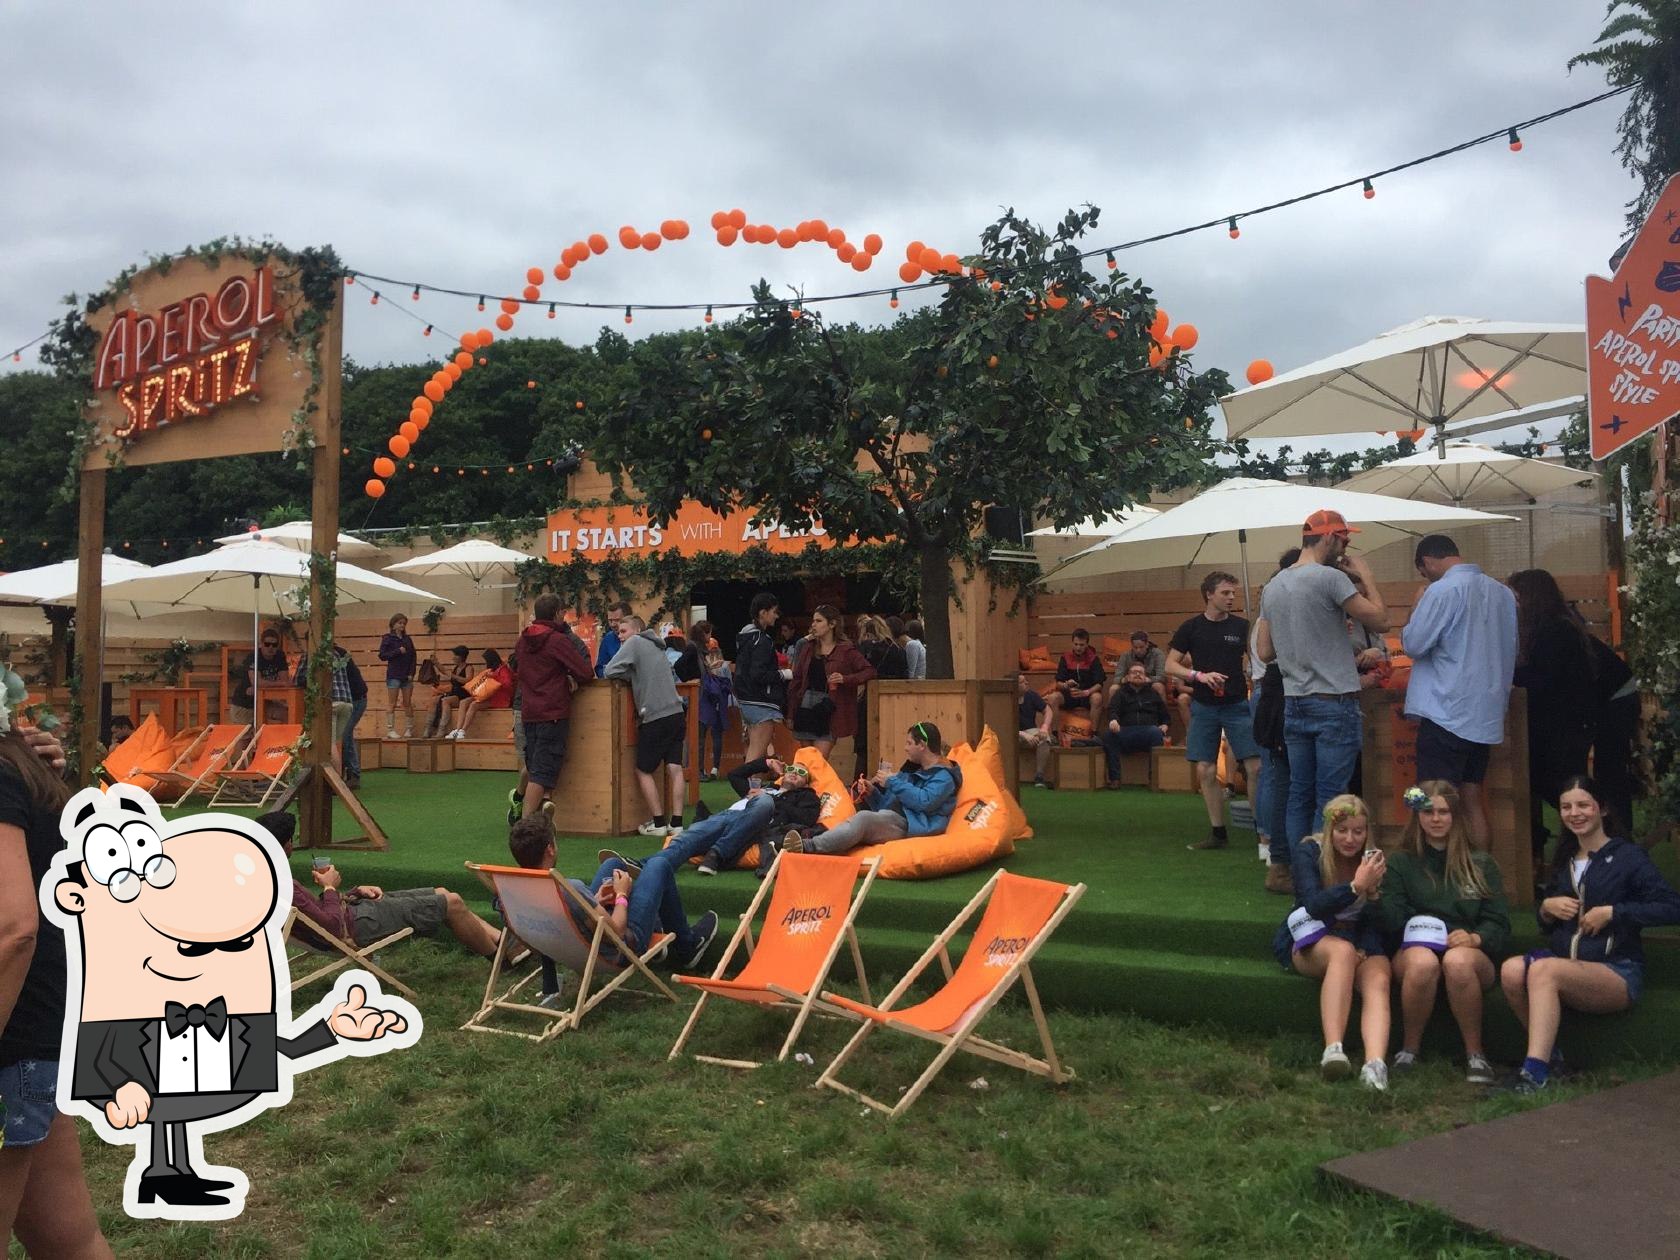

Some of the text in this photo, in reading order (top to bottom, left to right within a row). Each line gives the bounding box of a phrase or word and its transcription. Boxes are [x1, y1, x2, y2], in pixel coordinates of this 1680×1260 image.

[94, 266, 284, 390] APEROL
[1593, 329, 1656, 374] APEROL
[1609, 368, 1660, 404] STYLE
[552, 530, 570, 552] IT
[576, 523, 663, 550] STARTS
[680, 522, 722, 540] WITH
[781, 905, 831, 926] APEROL
